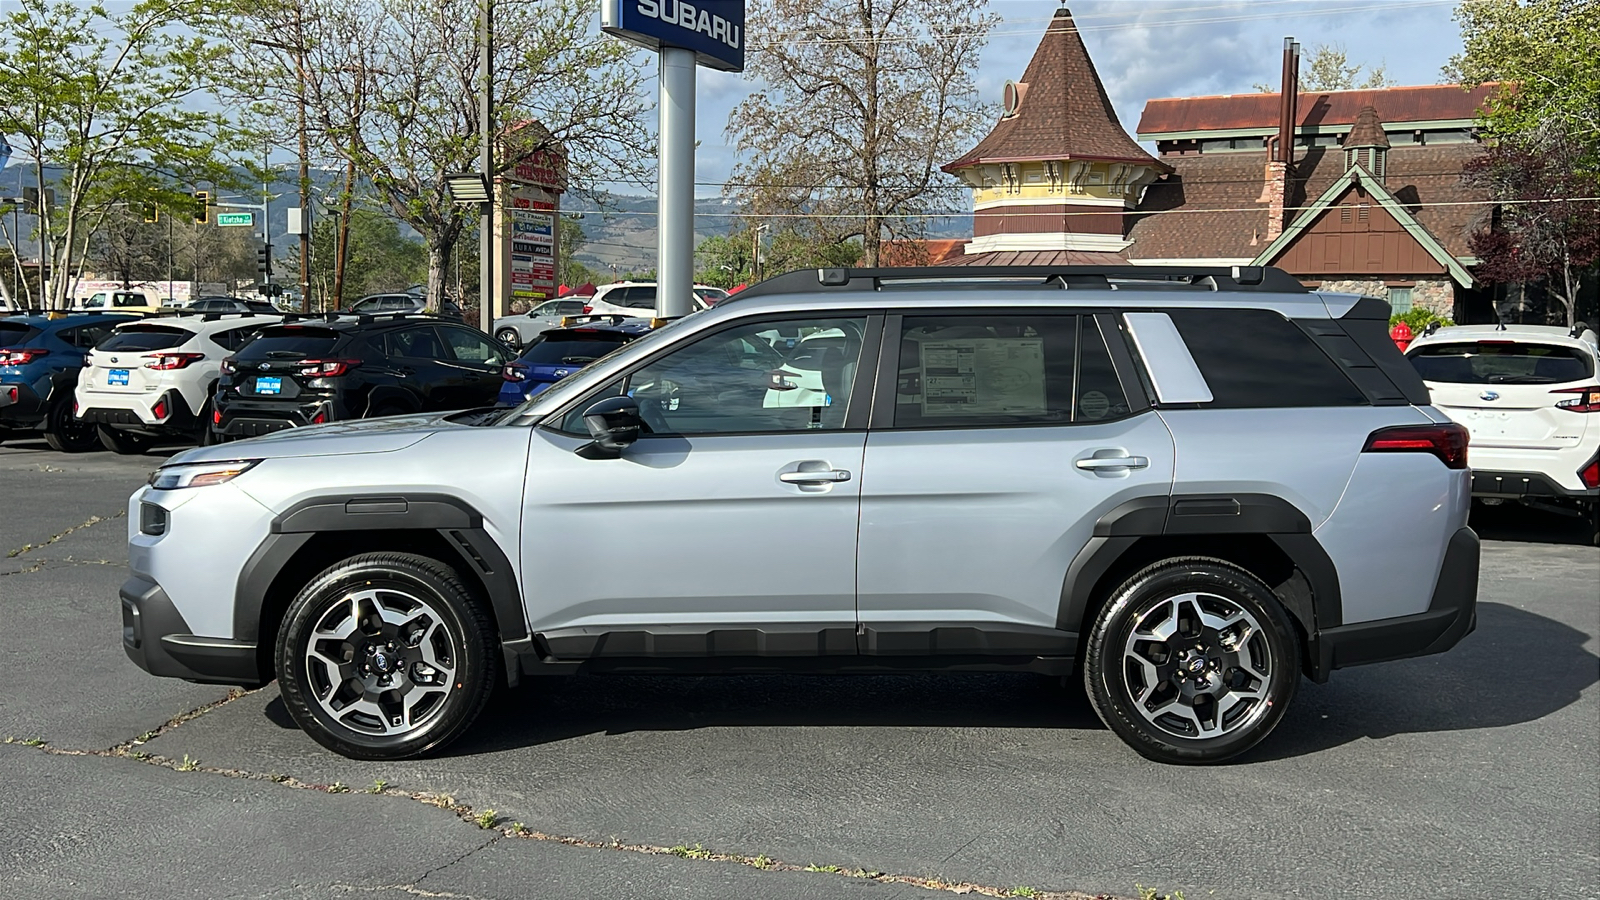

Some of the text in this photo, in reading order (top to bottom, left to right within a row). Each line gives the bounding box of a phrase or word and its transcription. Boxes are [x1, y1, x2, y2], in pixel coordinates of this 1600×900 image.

[637, 0, 739, 49] SUBARU
[223, 215, 243, 224] Kietzke
[514, 243, 551, 254] AURA AVEDA
